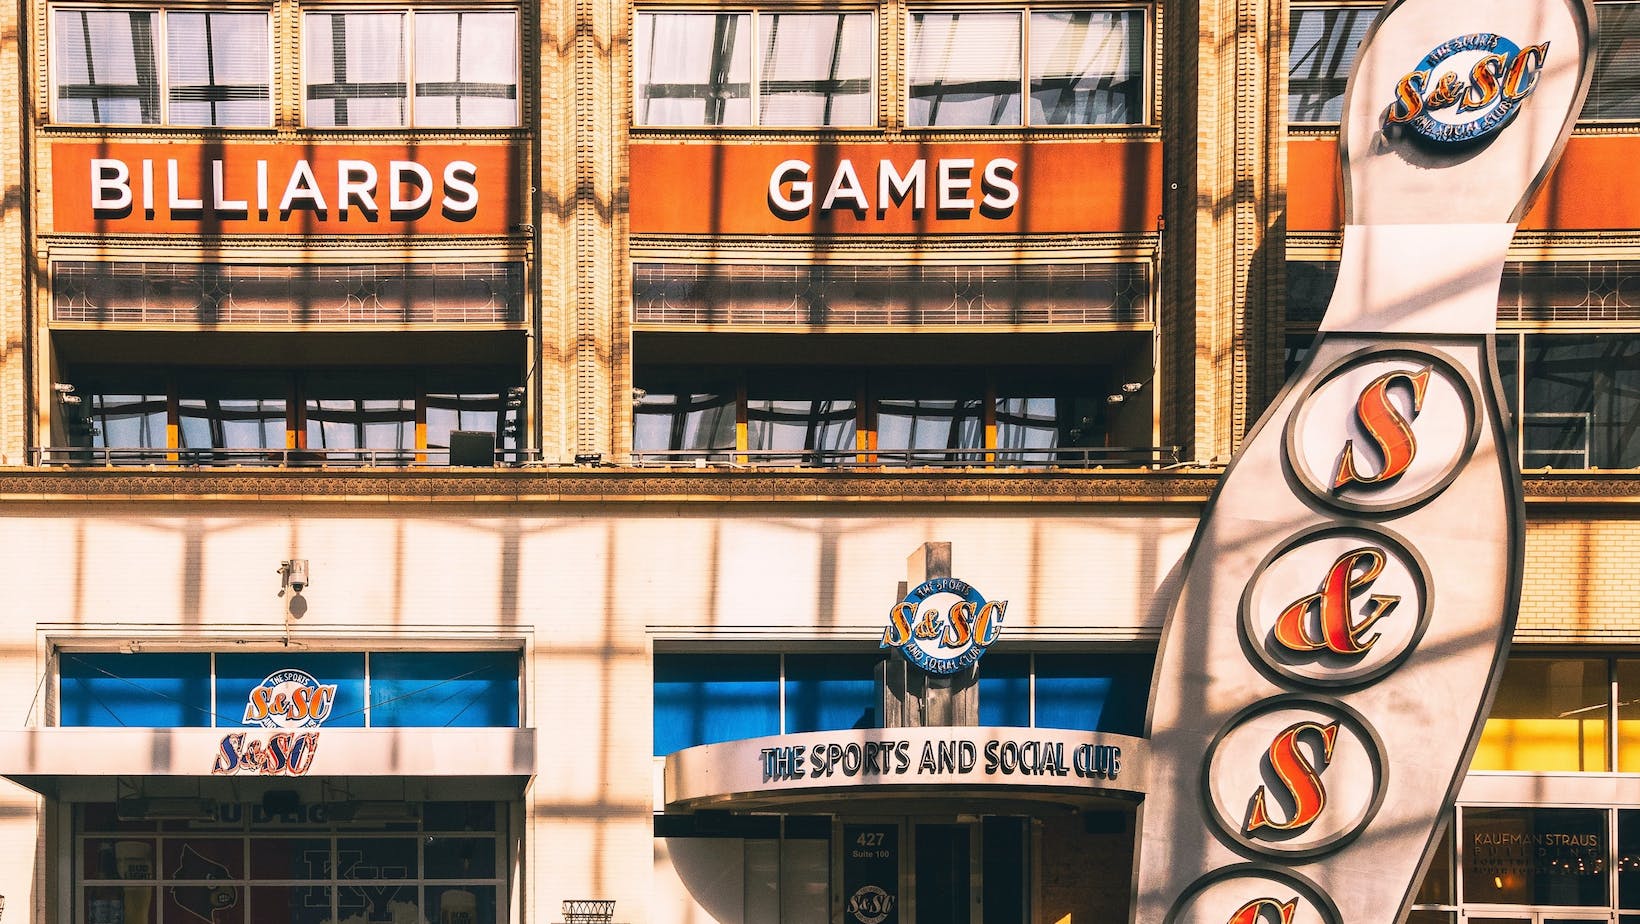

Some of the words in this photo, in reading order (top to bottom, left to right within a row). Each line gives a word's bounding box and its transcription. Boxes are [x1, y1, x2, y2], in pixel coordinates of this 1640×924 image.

[1386, 40, 1551, 126] S&SC
[90, 158, 480, 217] BILLIARDS
[768, 157, 1020, 216] GAMES
[1331, 363, 1433, 496] S
[917, 581, 934, 597] THE
[937, 579, 970, 595] SPORTS
[880, 600, 1008, 649] S&SC
[907, 643, 924, 660] AND
[923, 658, 959, 671] SOCIAL
[960, 646, 981, 666] CLUB
[270, 674, 283, 686] THE
[284, 673, 310, 686] SPORTS
[243, 685, 337, 723] S&SC
[212, 732, 320, 776] S&SC
[761, 746, 806, 778] THE
[811, 741, 910, 778] SPORTS
[919, 741, 976, 776] AND
[985, 741, 1070, 777] SOCIAL
[1073, 744, 1122, 780] CLUB
[1247, 719, 1341, 840] S
[852, 850, 873, 858] Suite
[876, 850, 890, 858] 100
[857, 832, 885, 847] 427
[1474, 832, 1542, 846] KAUFMAN
[1545, 833, 1598, 847] STRAUS
